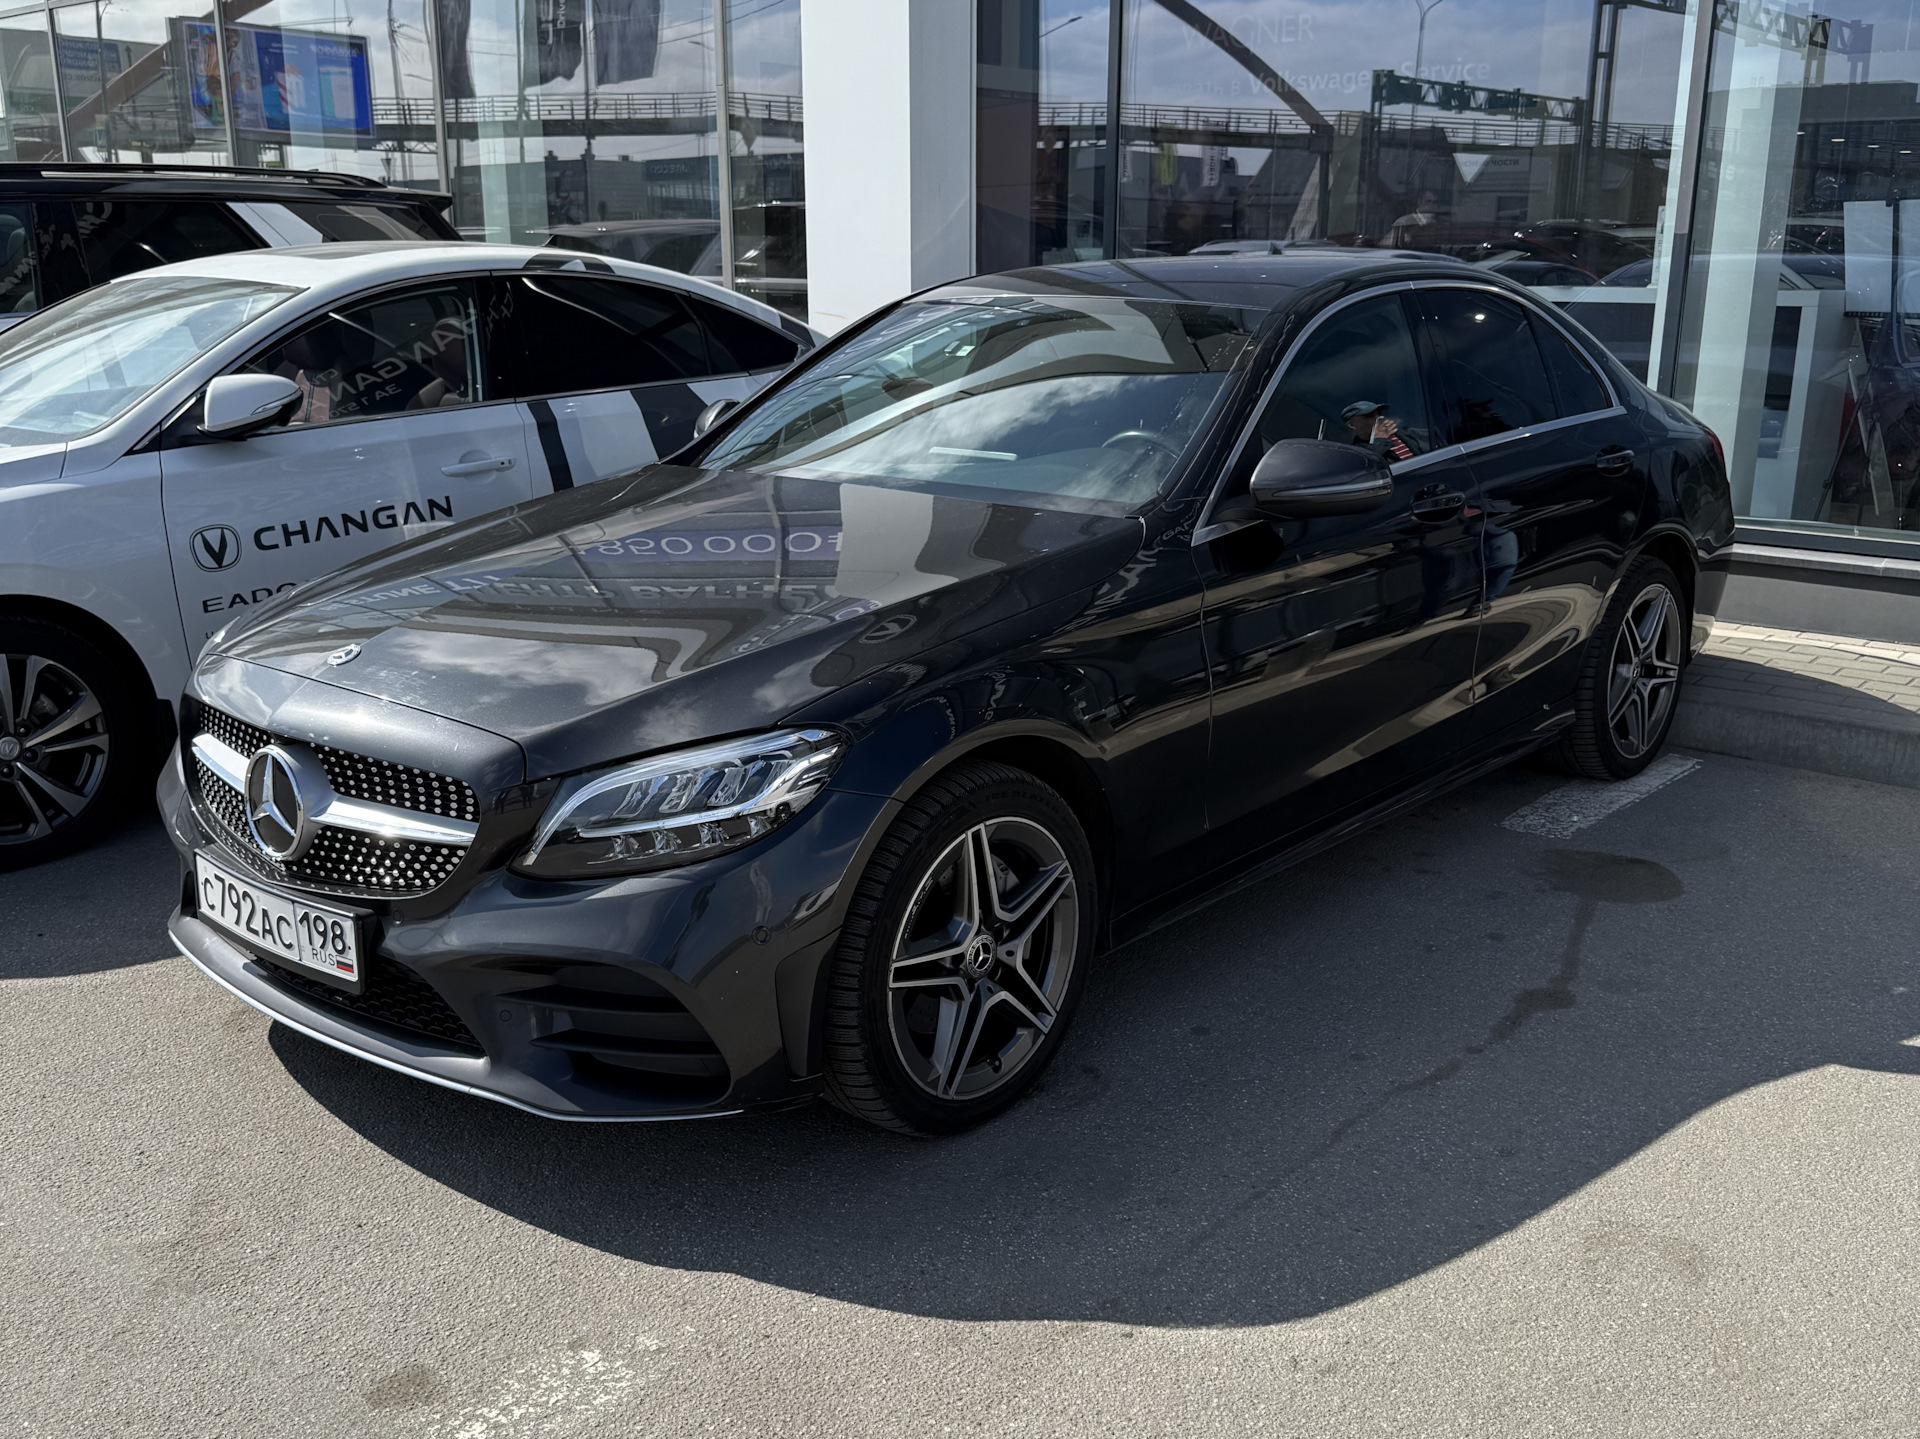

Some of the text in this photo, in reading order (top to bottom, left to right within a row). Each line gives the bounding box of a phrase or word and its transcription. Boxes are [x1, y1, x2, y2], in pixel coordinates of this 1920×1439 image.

[1182, 12, 1315, 50] WAGNER
[1248, 69, 1383, 95] Volkswagen
[1400, 57, 1490, 82] Service
[253, 495, 454, 551] CHANGAN
[298, 910, 347, 955] 198
[312, 948, 335, 966] RUS
